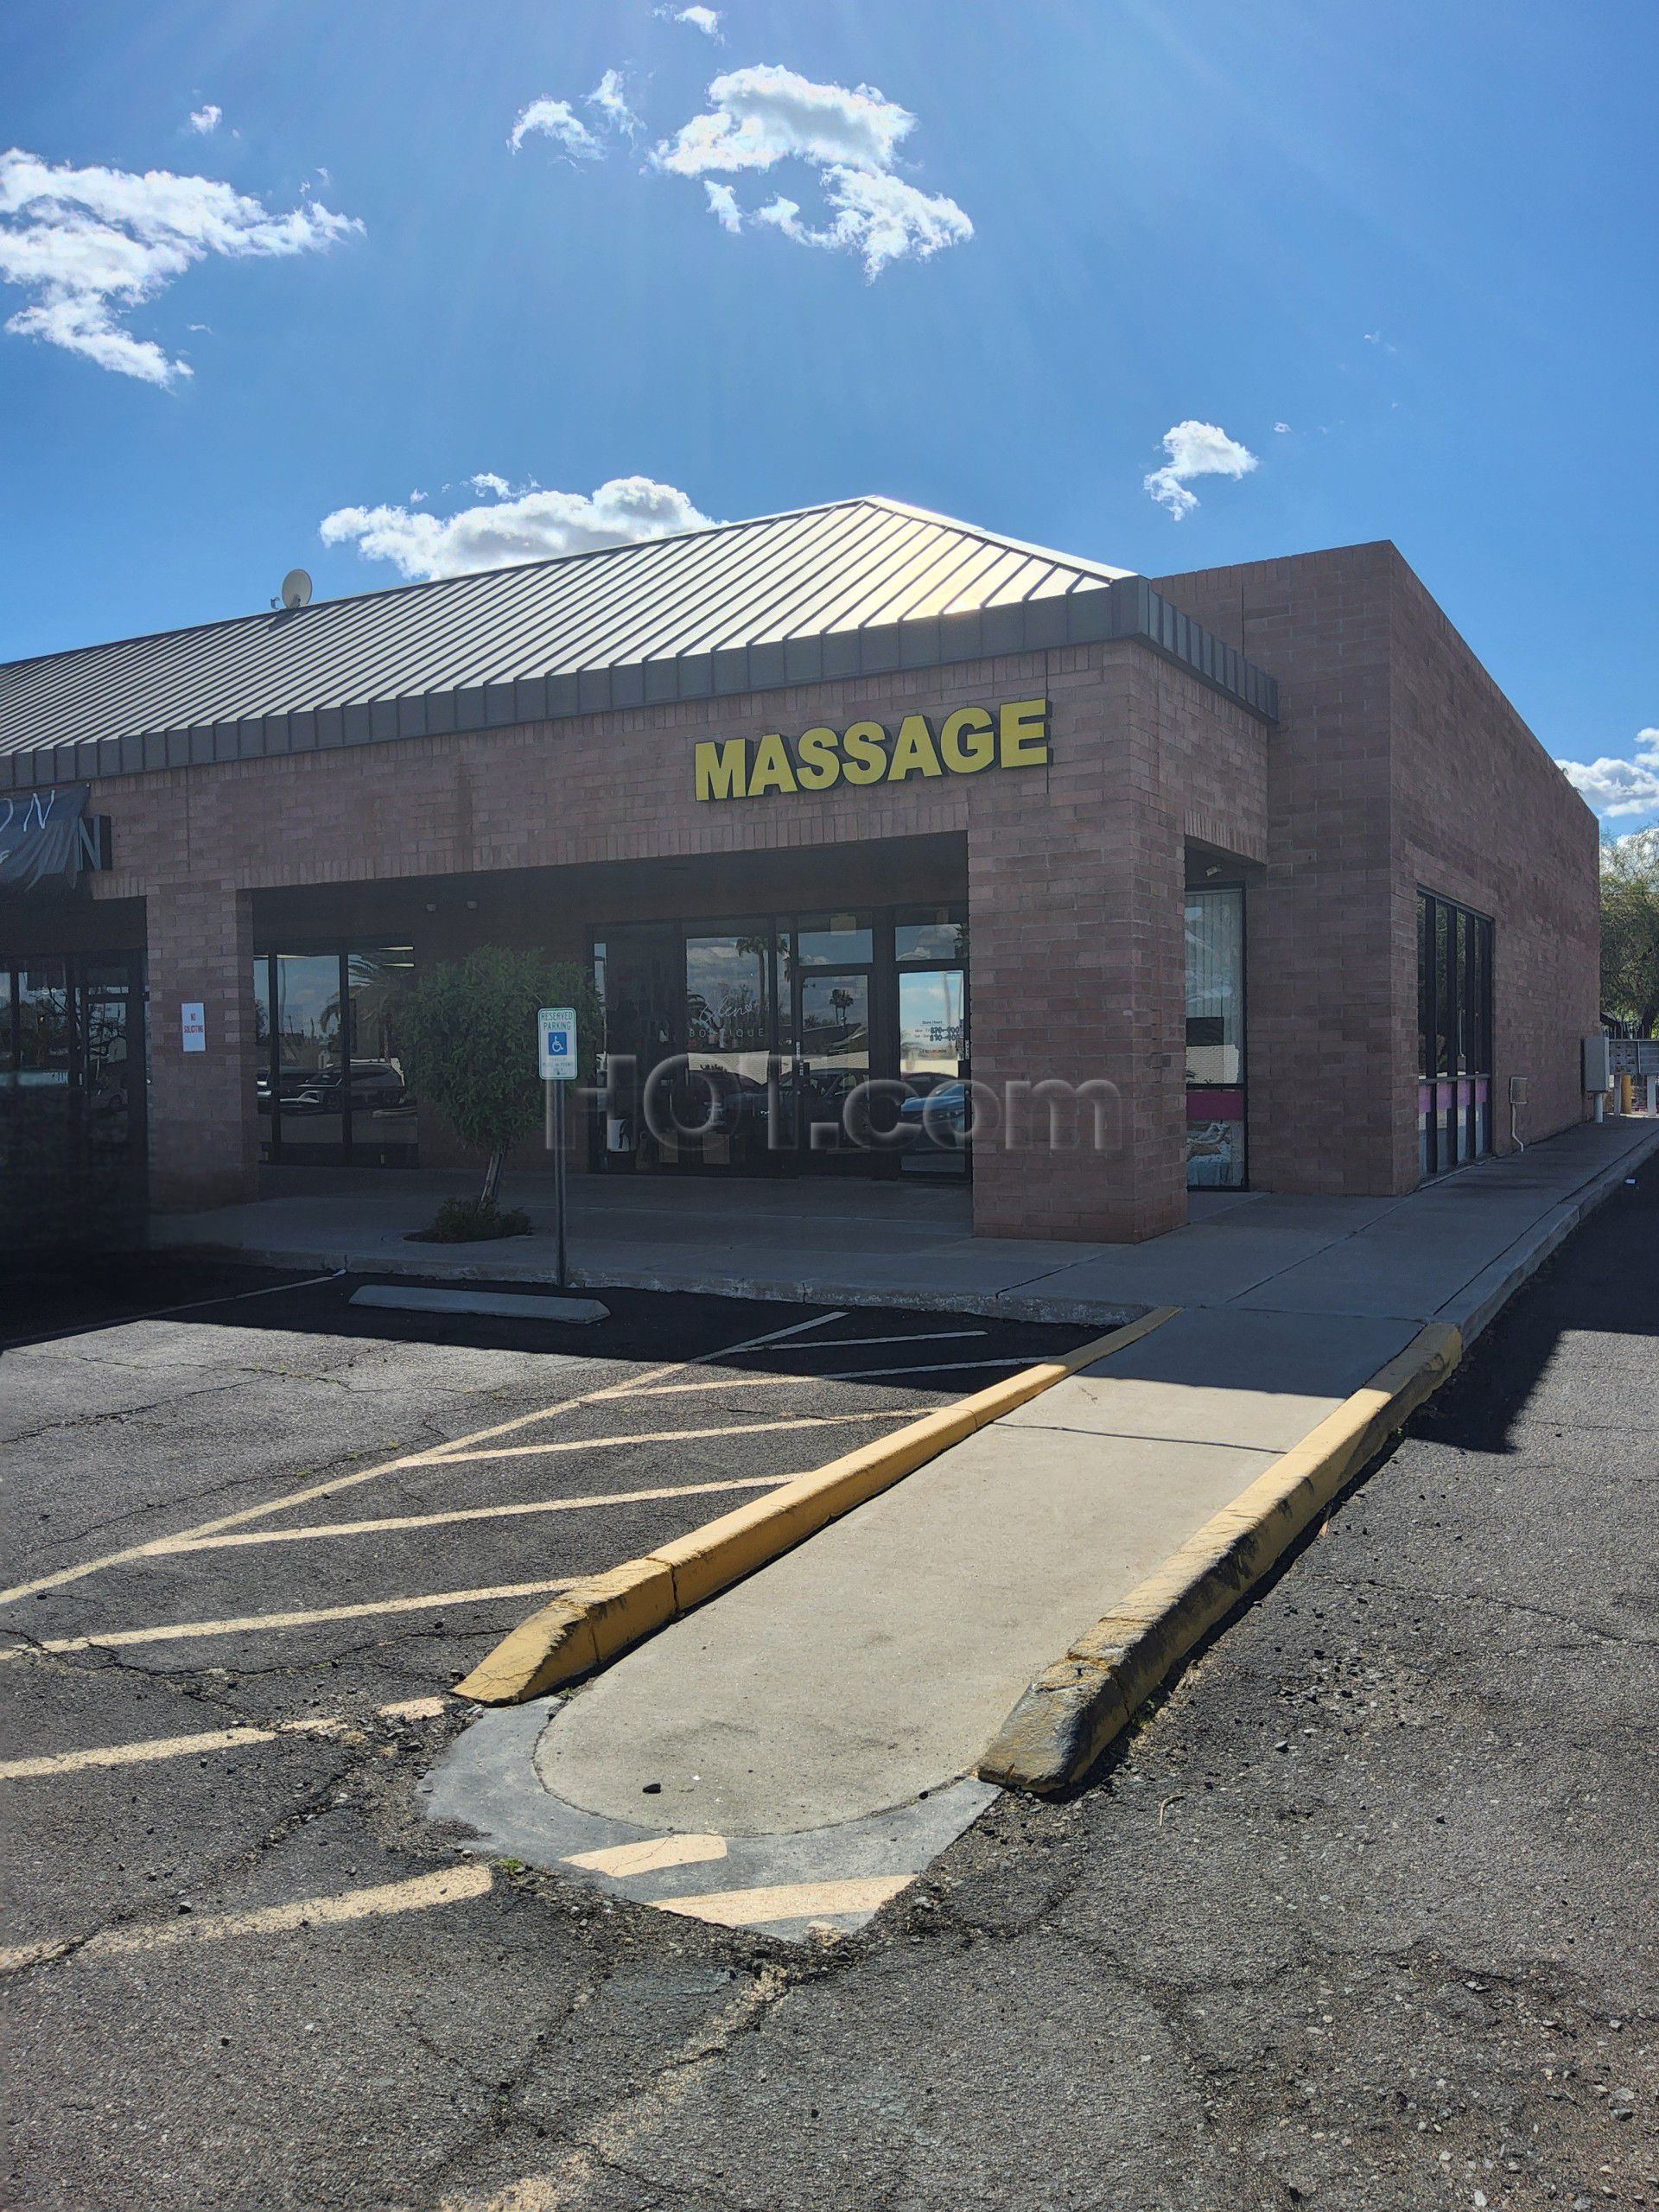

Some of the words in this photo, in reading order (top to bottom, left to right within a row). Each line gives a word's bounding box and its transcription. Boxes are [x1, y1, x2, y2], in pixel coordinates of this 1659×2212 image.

[695, 697, 1049, 802] MASSAGE
[541, 1012, 573, 1020] RESERVED
[543, 1021, 571, 1031] PARKING
